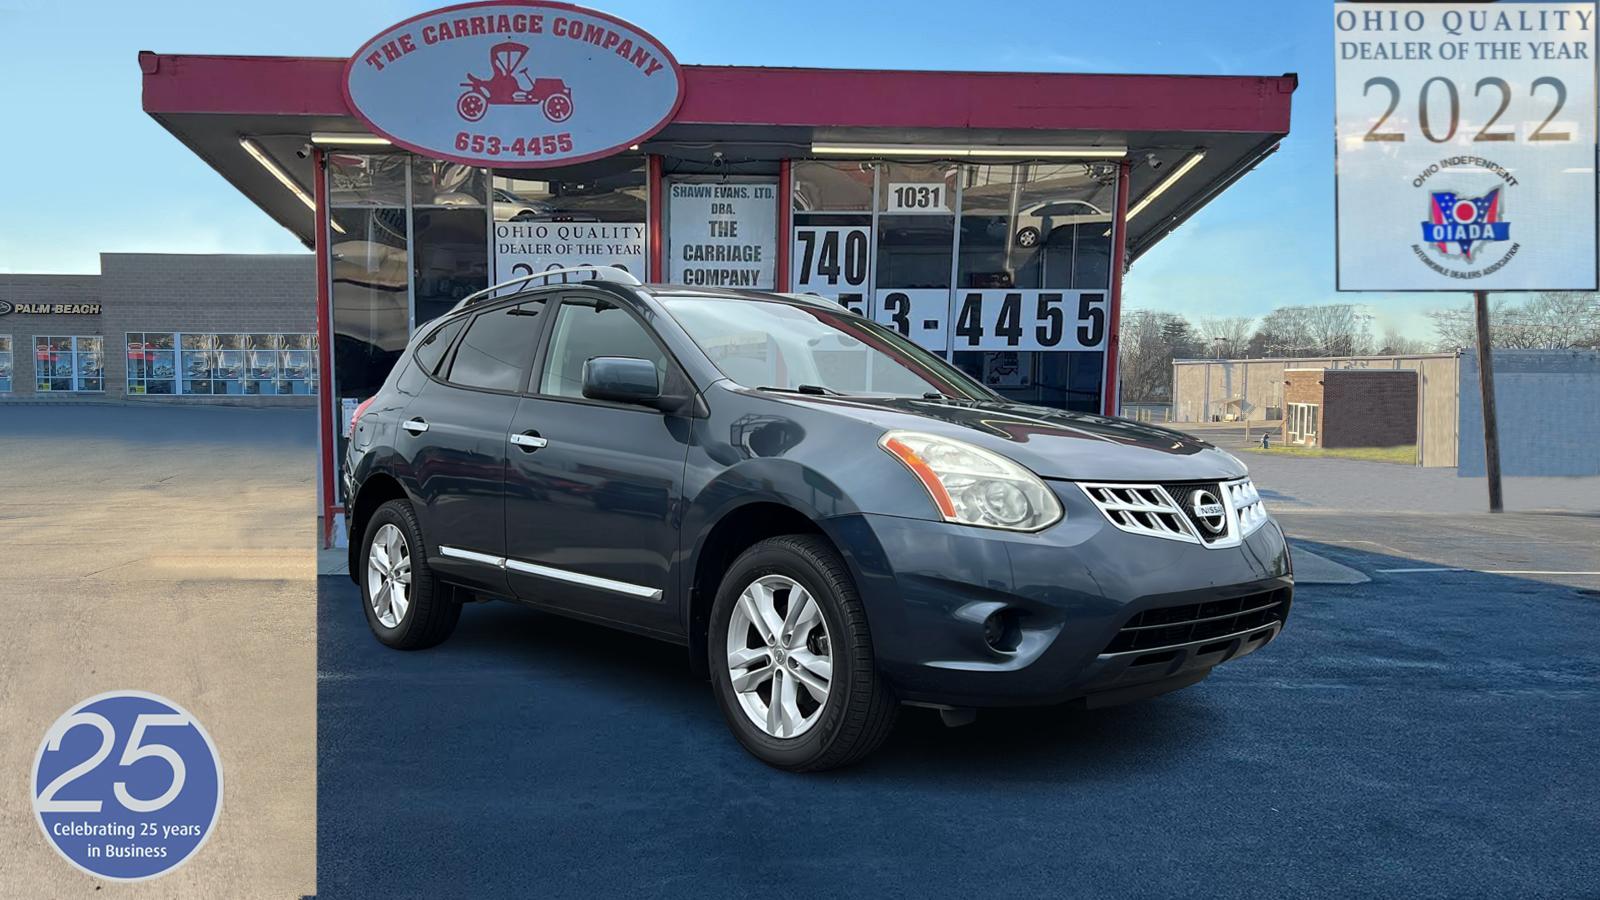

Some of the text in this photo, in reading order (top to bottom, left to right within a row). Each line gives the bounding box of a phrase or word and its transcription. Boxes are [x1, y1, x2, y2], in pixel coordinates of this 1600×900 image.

[1336, 10, 1593, 36] OHIO QUALITY
[365, 15, 664, 78] THE CARRIAGE COMPANY
[1340, 42, 1589, 60] DEALER OF THE YEAR
[1362, 76, 1571, 143] 2022
[454, 132, 573, 156] 653-4455
[1412, 156, 1519, 188] OHIO INDEPENDENT
[672, 185, 712, 198] SHAWN
[754, 187, 775, 199] LTD.
[894, 187, 941, 208] 1031
[711, 203, 736, 216] DBA.
[497, 225, 644, 241] OHIO QUALITY
[709, 220, 738, 238] THE
[1432, 224, 1495, 240] OIADA
[499, 243, 642, 255] DEALER OF THE YEAR
[683, 244, 762, 262] CARRIAGE
[798, 230, 868, 286] 740
[683, 268, 760, 286] COMPANY
[1450, 270, 1482, 279] DEALERS
[14, 303, 100, 314] PALM BEACH
